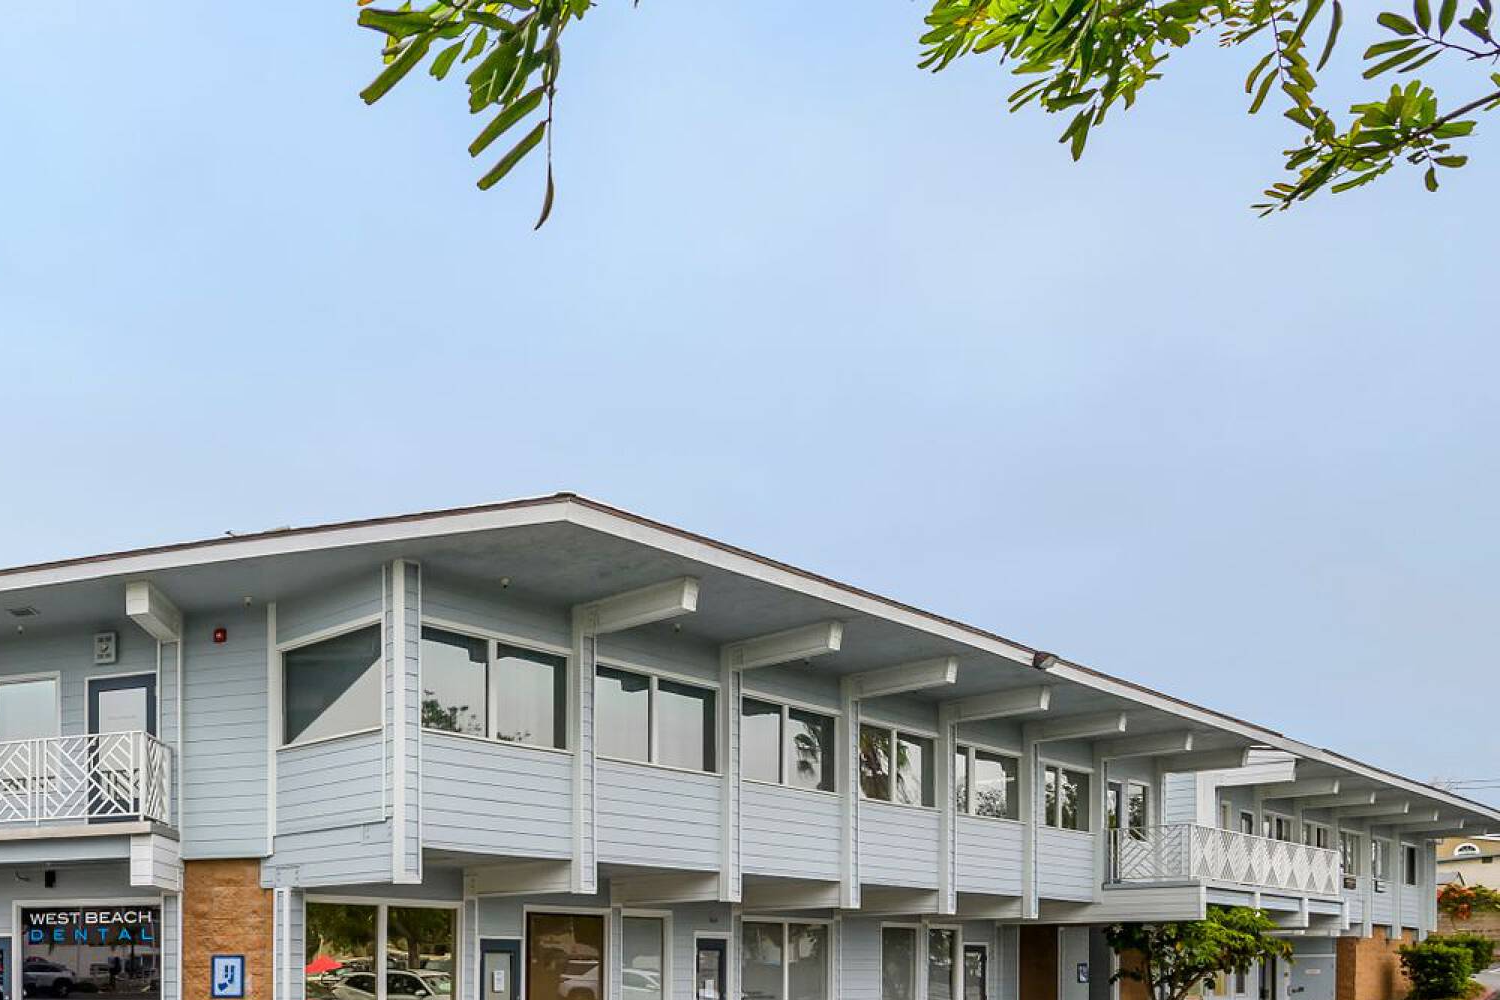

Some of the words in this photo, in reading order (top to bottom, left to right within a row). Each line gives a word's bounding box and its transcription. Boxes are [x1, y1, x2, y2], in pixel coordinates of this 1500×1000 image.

[29, 912, 81, 925] WEST
[84, 910, 152, 924] BEACH
[30, 926, 154, 941] DENTAL
